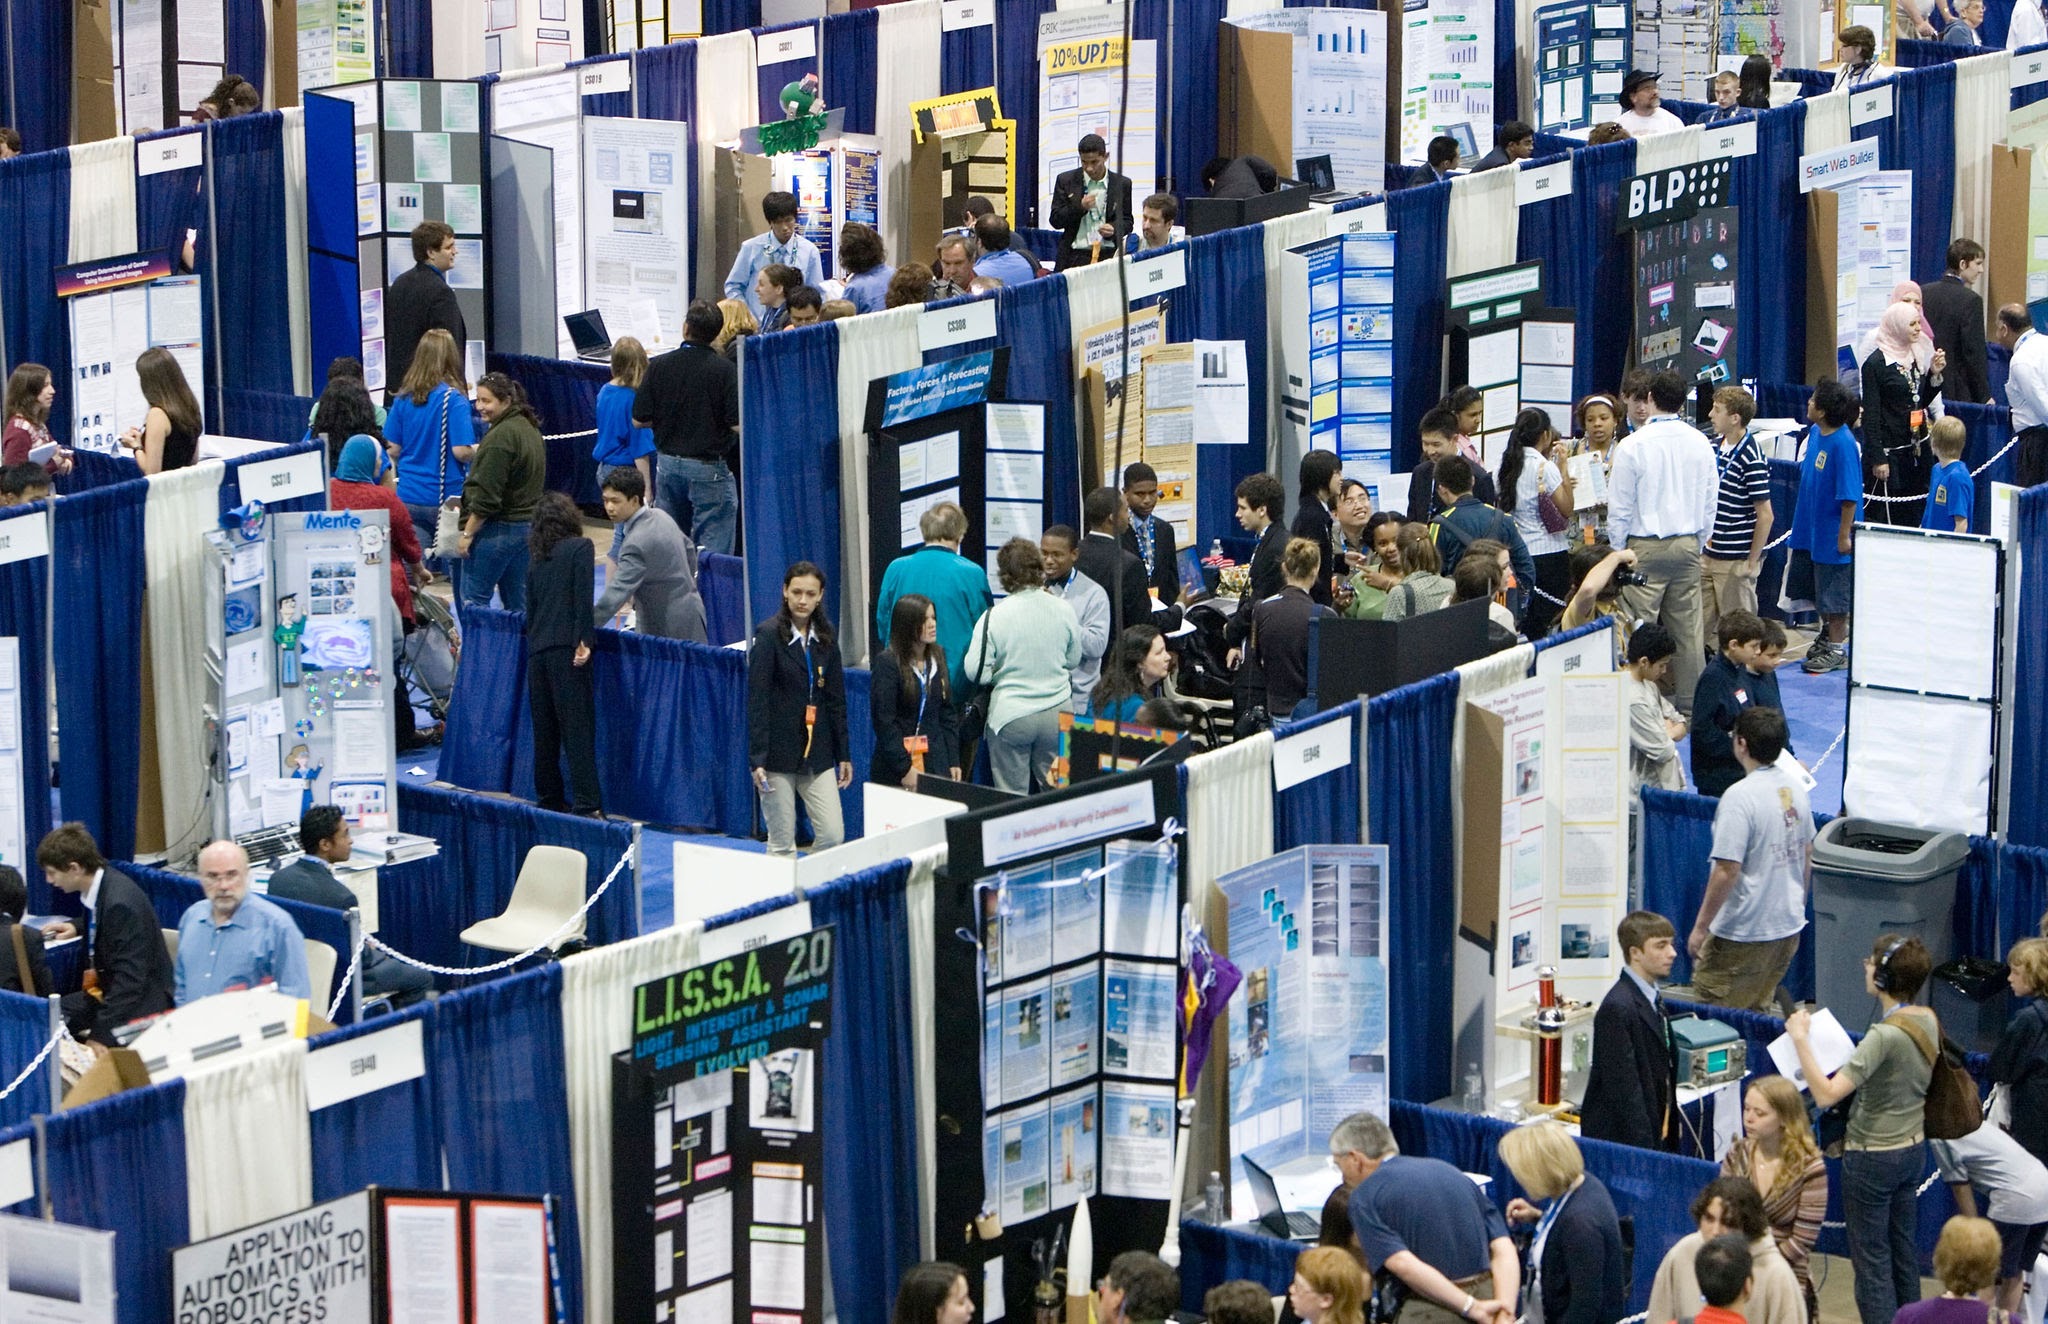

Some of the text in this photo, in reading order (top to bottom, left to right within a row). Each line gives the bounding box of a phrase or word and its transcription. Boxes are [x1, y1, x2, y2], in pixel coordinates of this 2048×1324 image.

[1040, 22, 1058, 35] CRIK
[1277, 20, 1309, 28] Analysis
[1052, 43, 1101, 68] 20% UP
[584, 74, 603, 85] CS019
[1806, 151, 1875, 179] Smart Web Builder
[1629, 170, 1686, 218] BLP
[1348, 220, 1363, 232] CS304
[76, 270, 98, 279] Computer
[98, 264, 128, 275] Determination
[133, 261, 149, 269] Gender
[127, 269, 143, 277] Images
[948, 318, 966, 333] CS308
[887, 365, 990, 399] Factors, Forces & Forecasting
[905, 397, 923, 408] Market
[923, 391, 946, 403] Modeling
[946, 388, 957, 396] and
[957, 381, 985, 393] Simulation
[304, 508, 362, 531] Mente
[1493, 697, 1510, 707] Power
[1510, 686, 1545, 701] Transmission
[1497, 705, 1519, 716] Through
[1515, 710, 1544, 723] Resonance
[1095, 804, 1129, 820] Experiment
[1311, 851, 1374, 859] Experiment Images
[637, 929, 831, 1034] L.I.S.S.A. 2.0
[635, 982, 829, 1059] LIGHT INTENSITY & SONAR
[655, 1006, 810, 1071] SENSING ASSISTANT
[695, 1040, 769, 1078] EVOLVED
[226, 1210, 333, 1268] APPLYING
[181, 1228, 365, 1310] AUTOMATION TO
[309, 1254, 367, 1294] WITH
